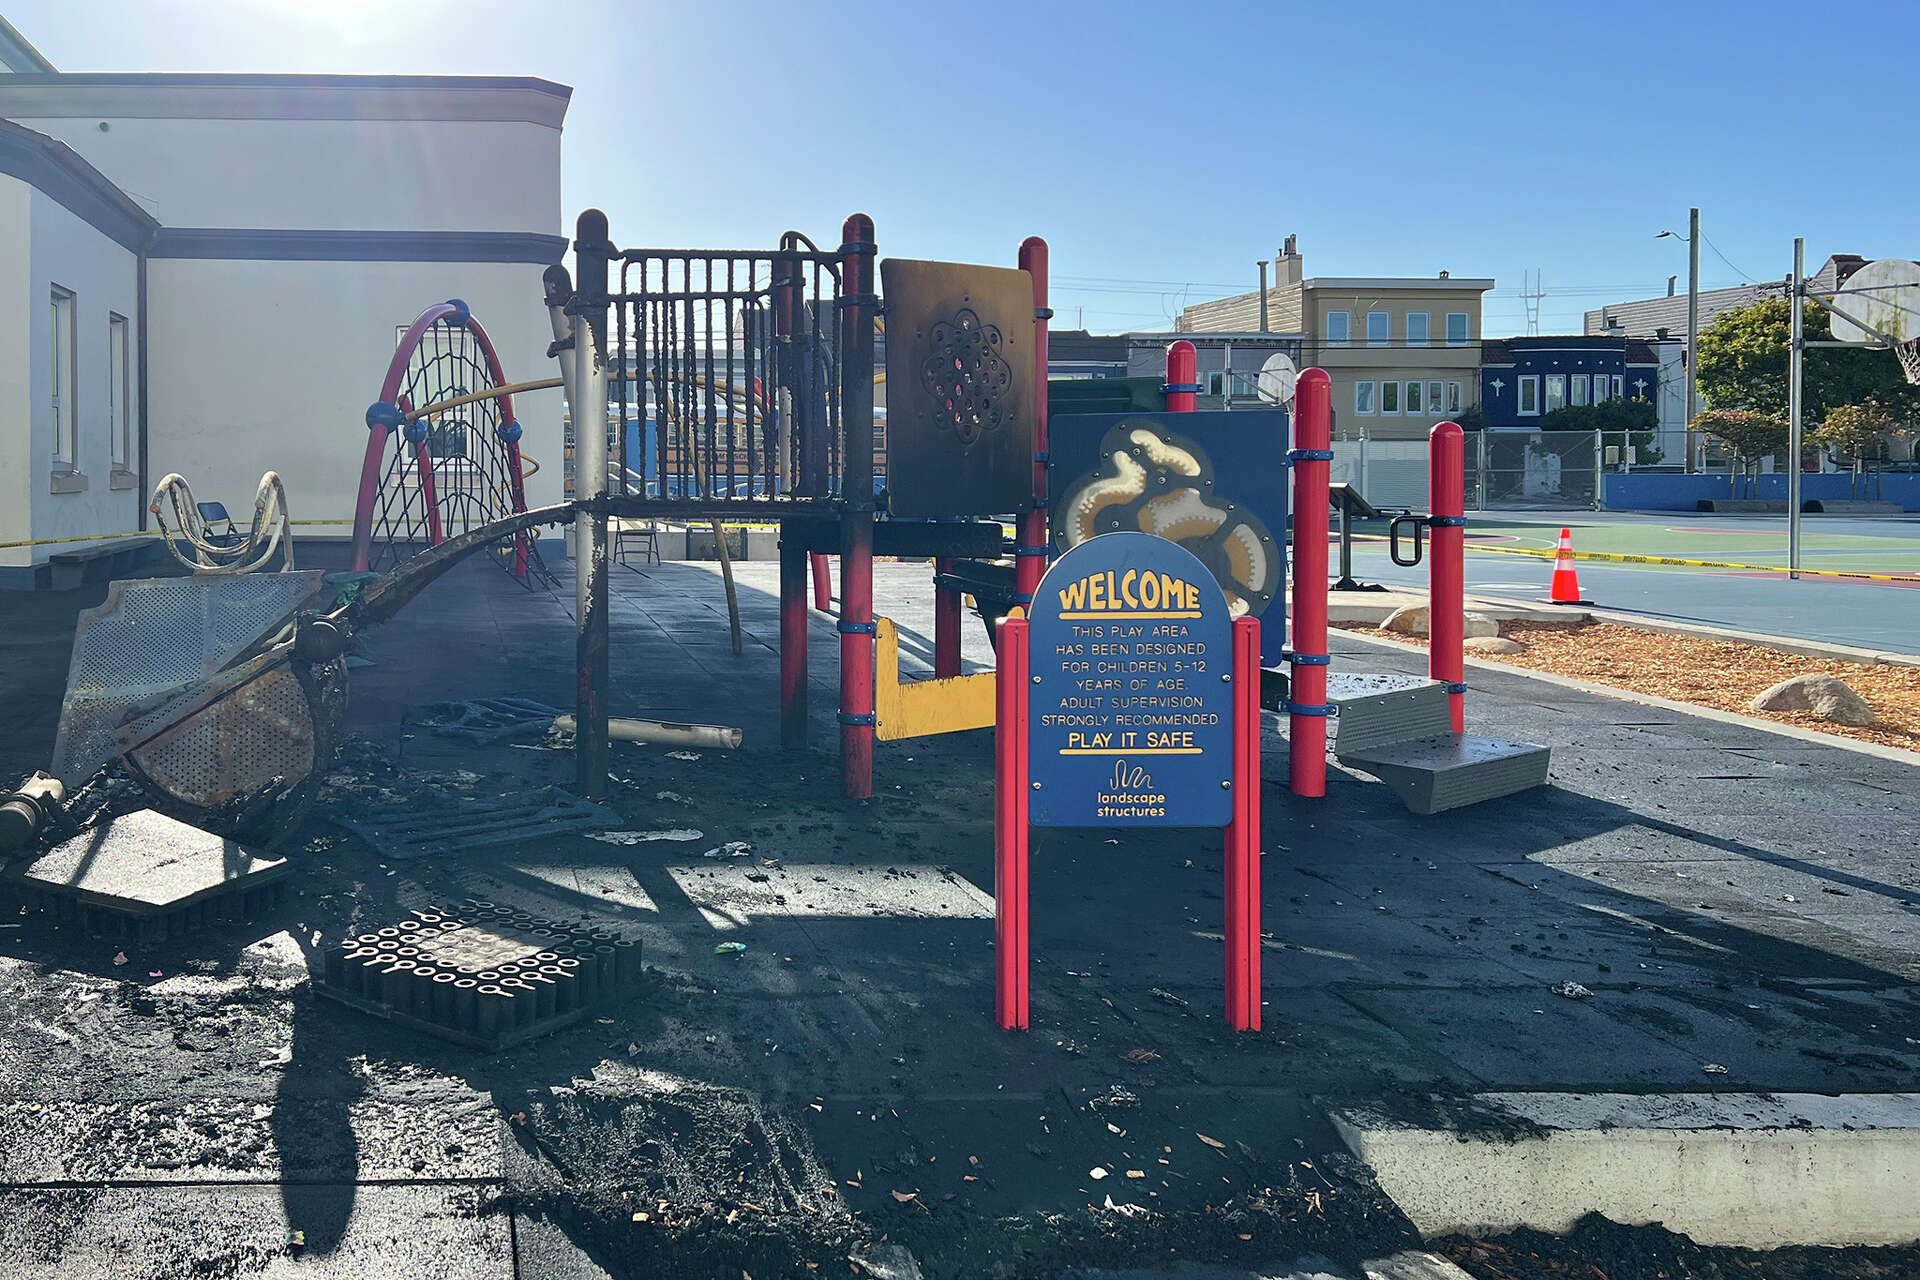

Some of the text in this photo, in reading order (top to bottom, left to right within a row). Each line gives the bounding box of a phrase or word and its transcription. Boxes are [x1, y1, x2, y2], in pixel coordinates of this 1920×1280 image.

[1058, 568, 1201, 610] WELCOME
[1072, 626, 1189, 638] THIS PLAY AREA
[1056, 643, 1206, 655] HAS BEEN DESIGNED
[1062, 661, 1207, 673] FOR CHILDREN 5-12
[1076, 679, 1189, 691] YEARS OF AGE.
[1060, 697, 1203, 709] ADULT SUPERVISION
[1041, 714, 1219, 726] STRONGLY RECOMMENDED
[1069, 732, 1194, 748] PLAY IT SAFE
[1097, 792, 1166, 806] landscape
[1097, 806, 1166, 817] structures
